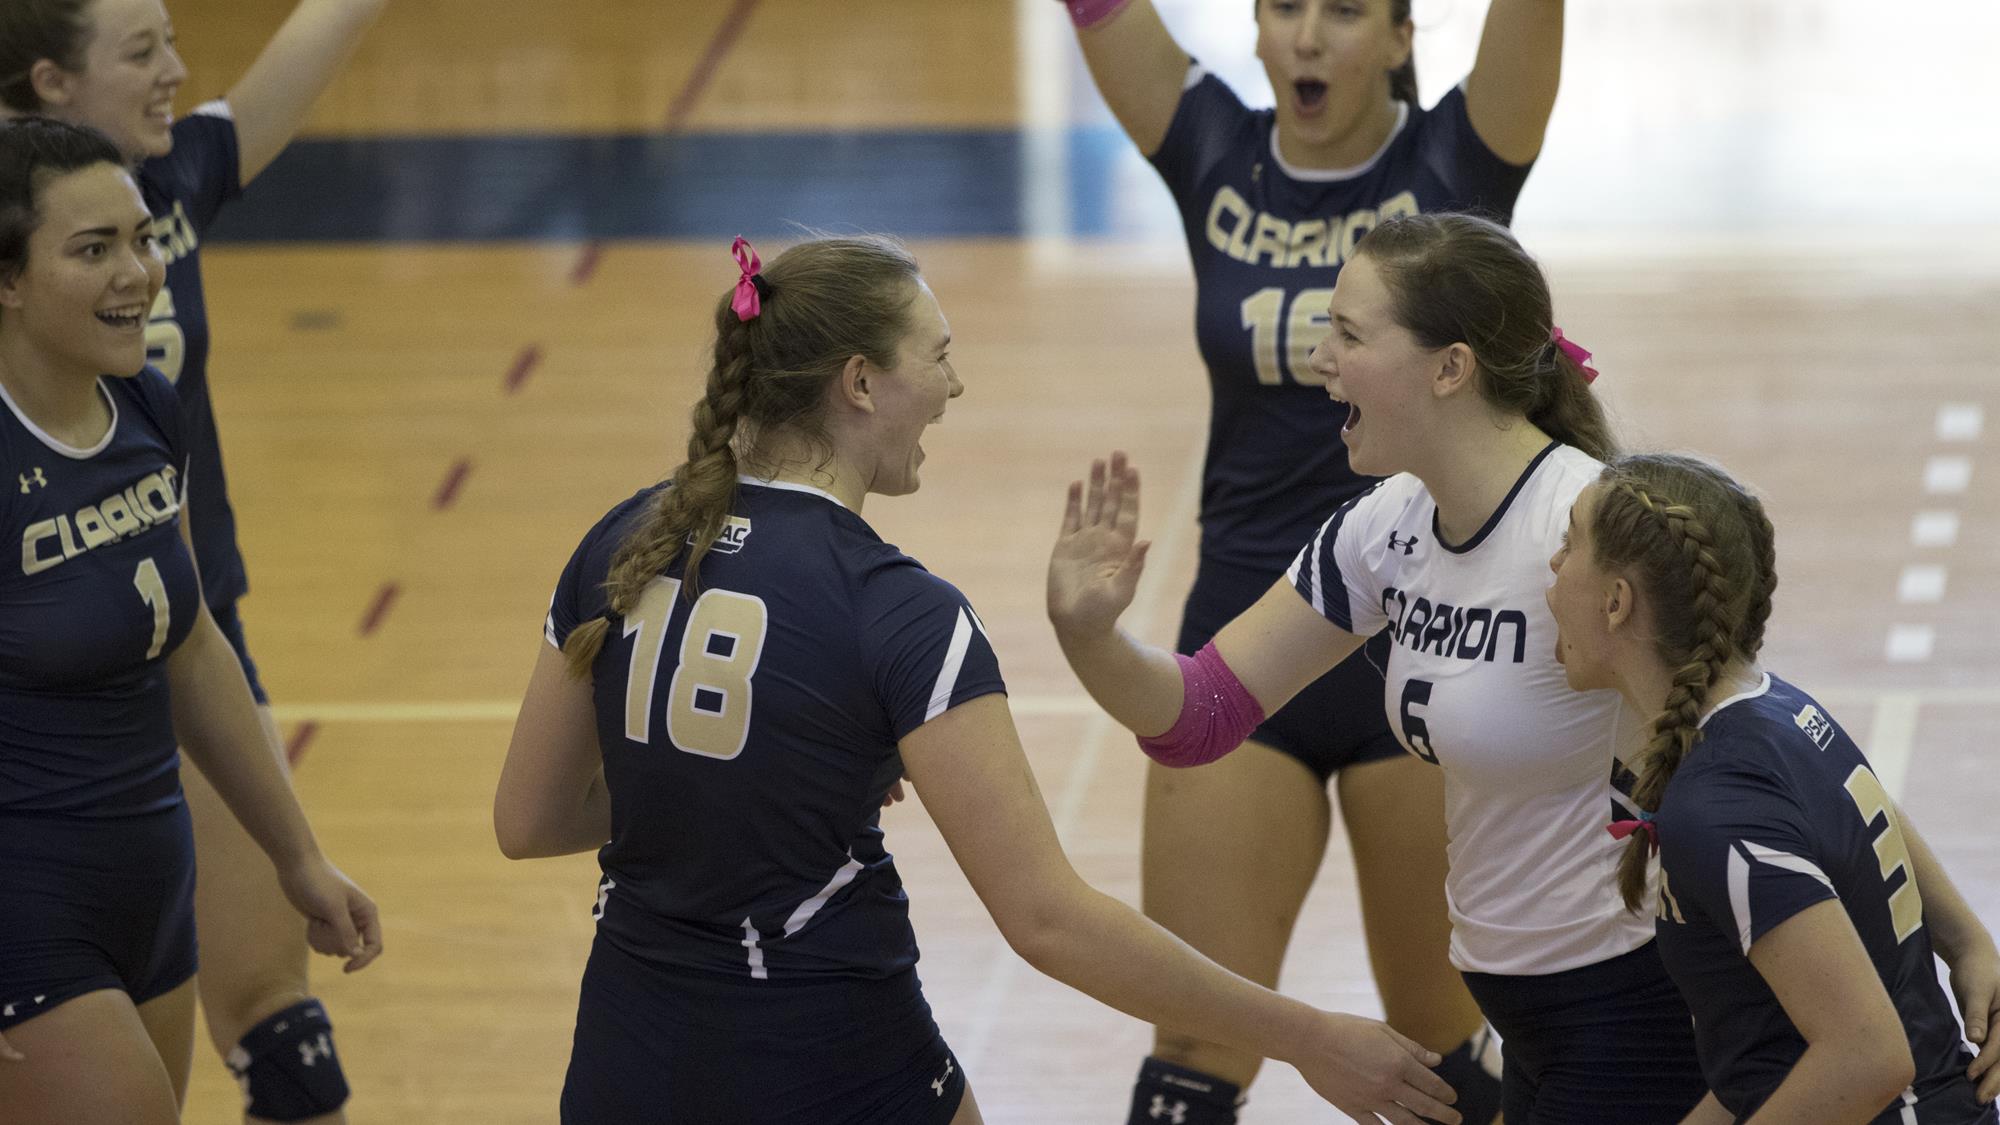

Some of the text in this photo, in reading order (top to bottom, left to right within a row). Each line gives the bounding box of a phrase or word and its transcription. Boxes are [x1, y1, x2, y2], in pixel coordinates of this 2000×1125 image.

[133, 557, 170, 660] 1
[1382, 587, 1526, 664] CLARION
[623, 575, 768, 761] 18
[1401, 678, 1440, 766] 6
[1844, 763, 1923, 945] 3
